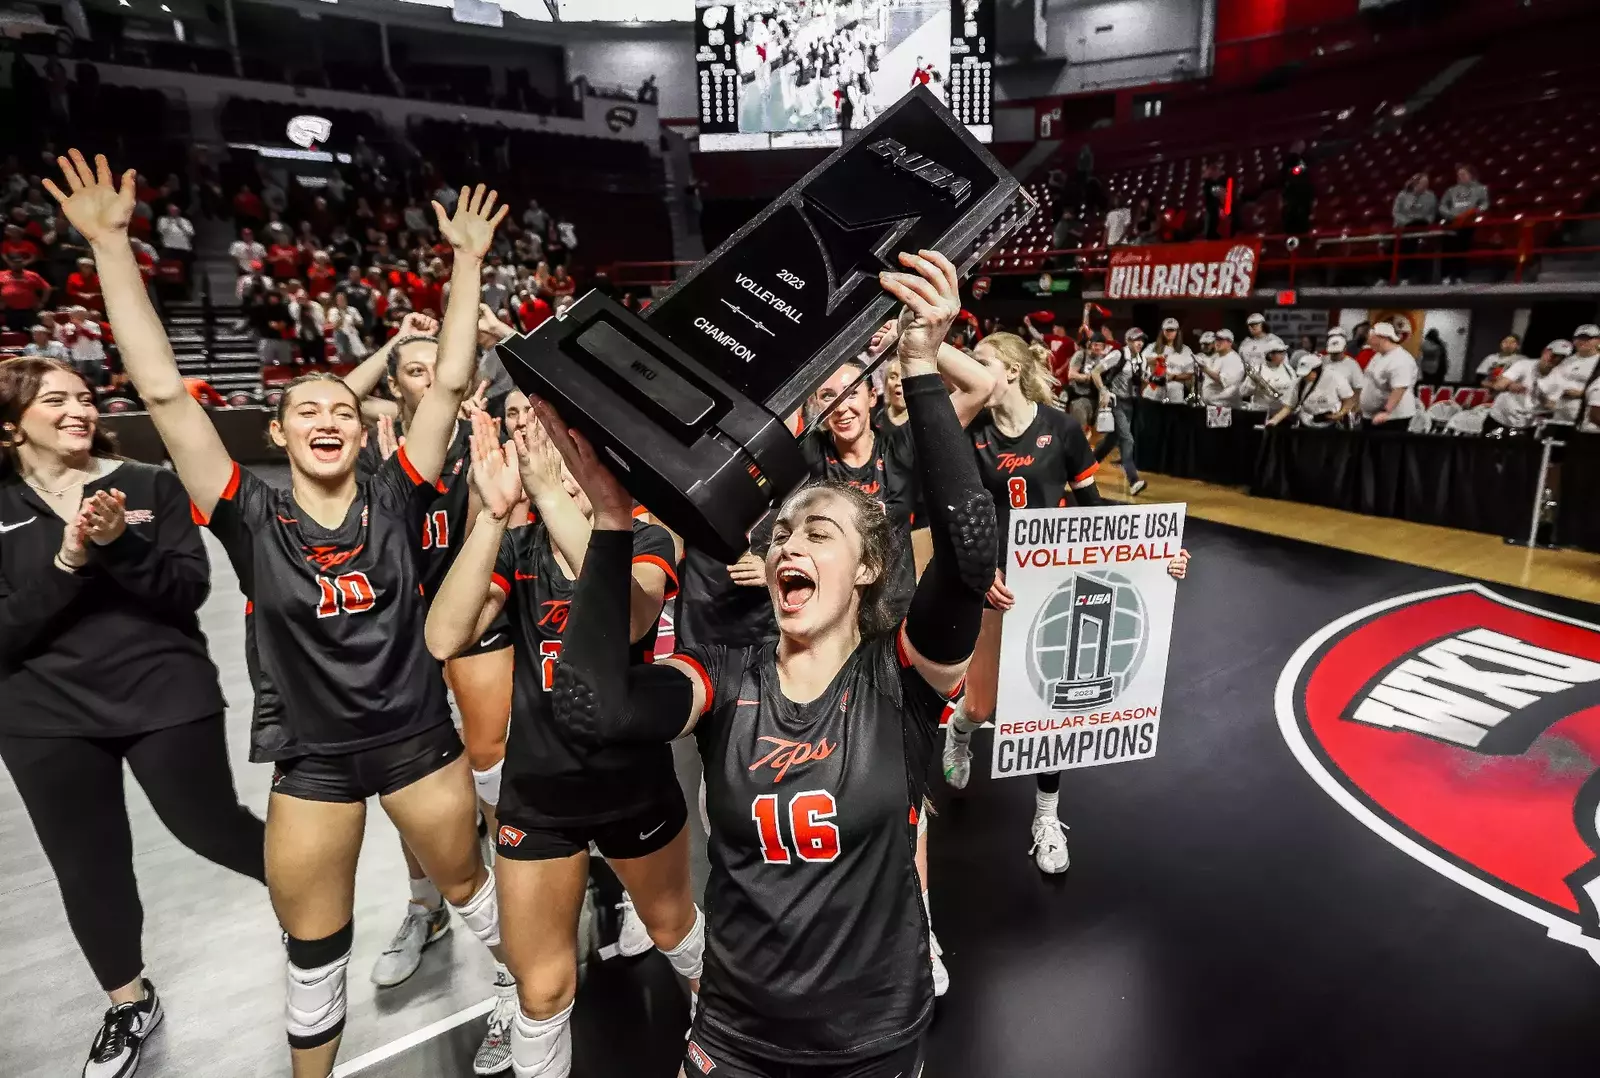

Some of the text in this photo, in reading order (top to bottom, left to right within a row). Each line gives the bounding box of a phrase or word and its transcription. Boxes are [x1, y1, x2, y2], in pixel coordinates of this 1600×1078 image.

[775, 268, 806, 290] 2023
[1108, 260, 1253, 299] HILLRAISERS
[734, 272, 804, 325] VOLLEYBALL
[693, 316, 756, 363] CHAMPION
[996, 452, 1035, 474] Tops
[1007, 476, 1028, 509] 8
[1013, 512, 1179, 546] CONFERENCE USA
[302, 544, 364, 572] Top
[1014, 542, 1176, 568] VOLLEYBALL
[315, 570, 377, 619] 10
[1074, 689, 1094, 698] 2023
[1352, 627, 1600, 748] WKU
[1000, 706, 1158, 735] REGULAR SEASON
[748, 735, 837, 783] Tops
[997, 722, 1154, 773] CHAMPIONS
[751, 789, 841, 865] 16
